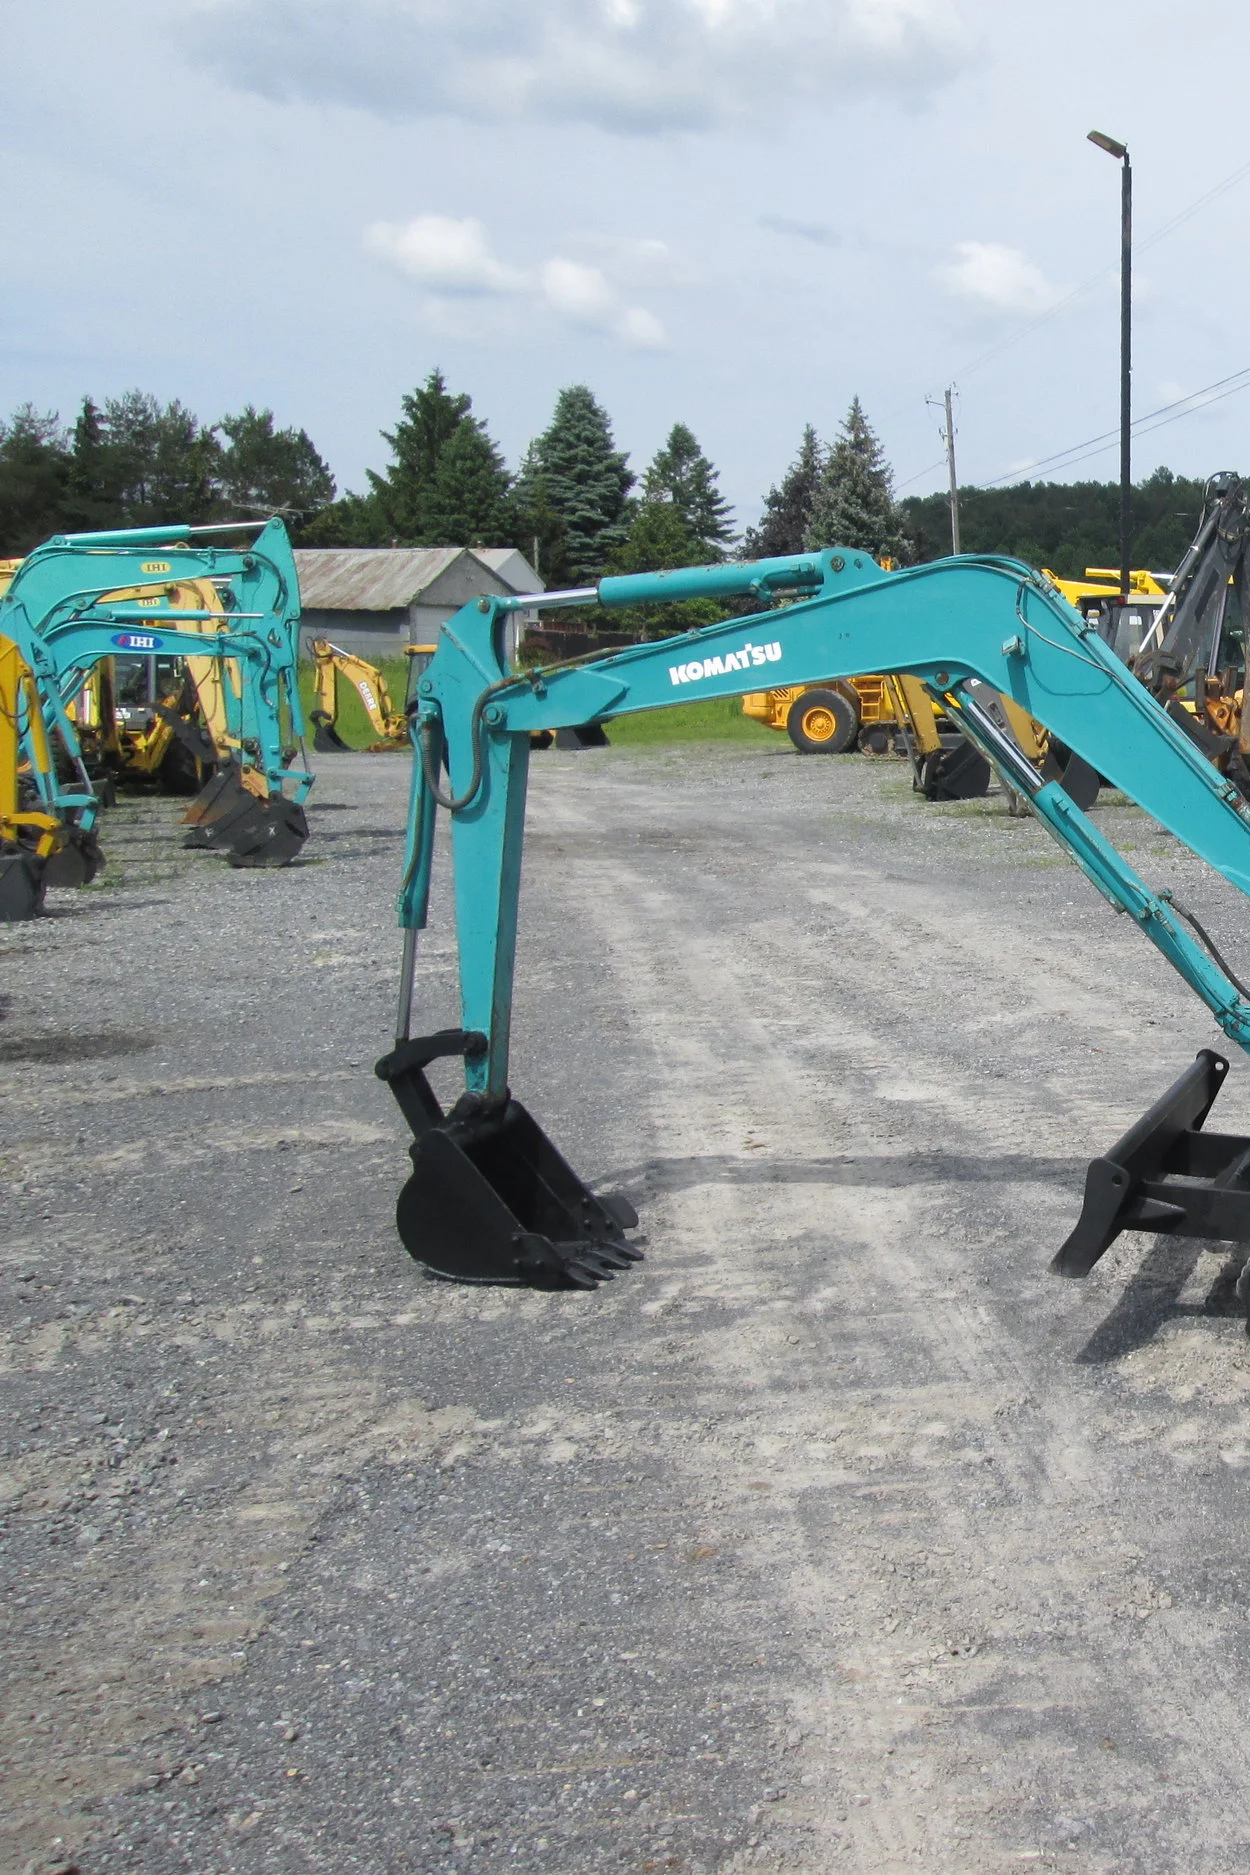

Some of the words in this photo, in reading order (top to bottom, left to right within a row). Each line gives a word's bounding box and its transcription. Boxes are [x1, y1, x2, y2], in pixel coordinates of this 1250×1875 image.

[147, 563, 167, 573] IHI
[129, 635, 155, 649] IHI
[669, 642, 782, 685] KOMATSU
[359, 681, 378, 711] DEERE
